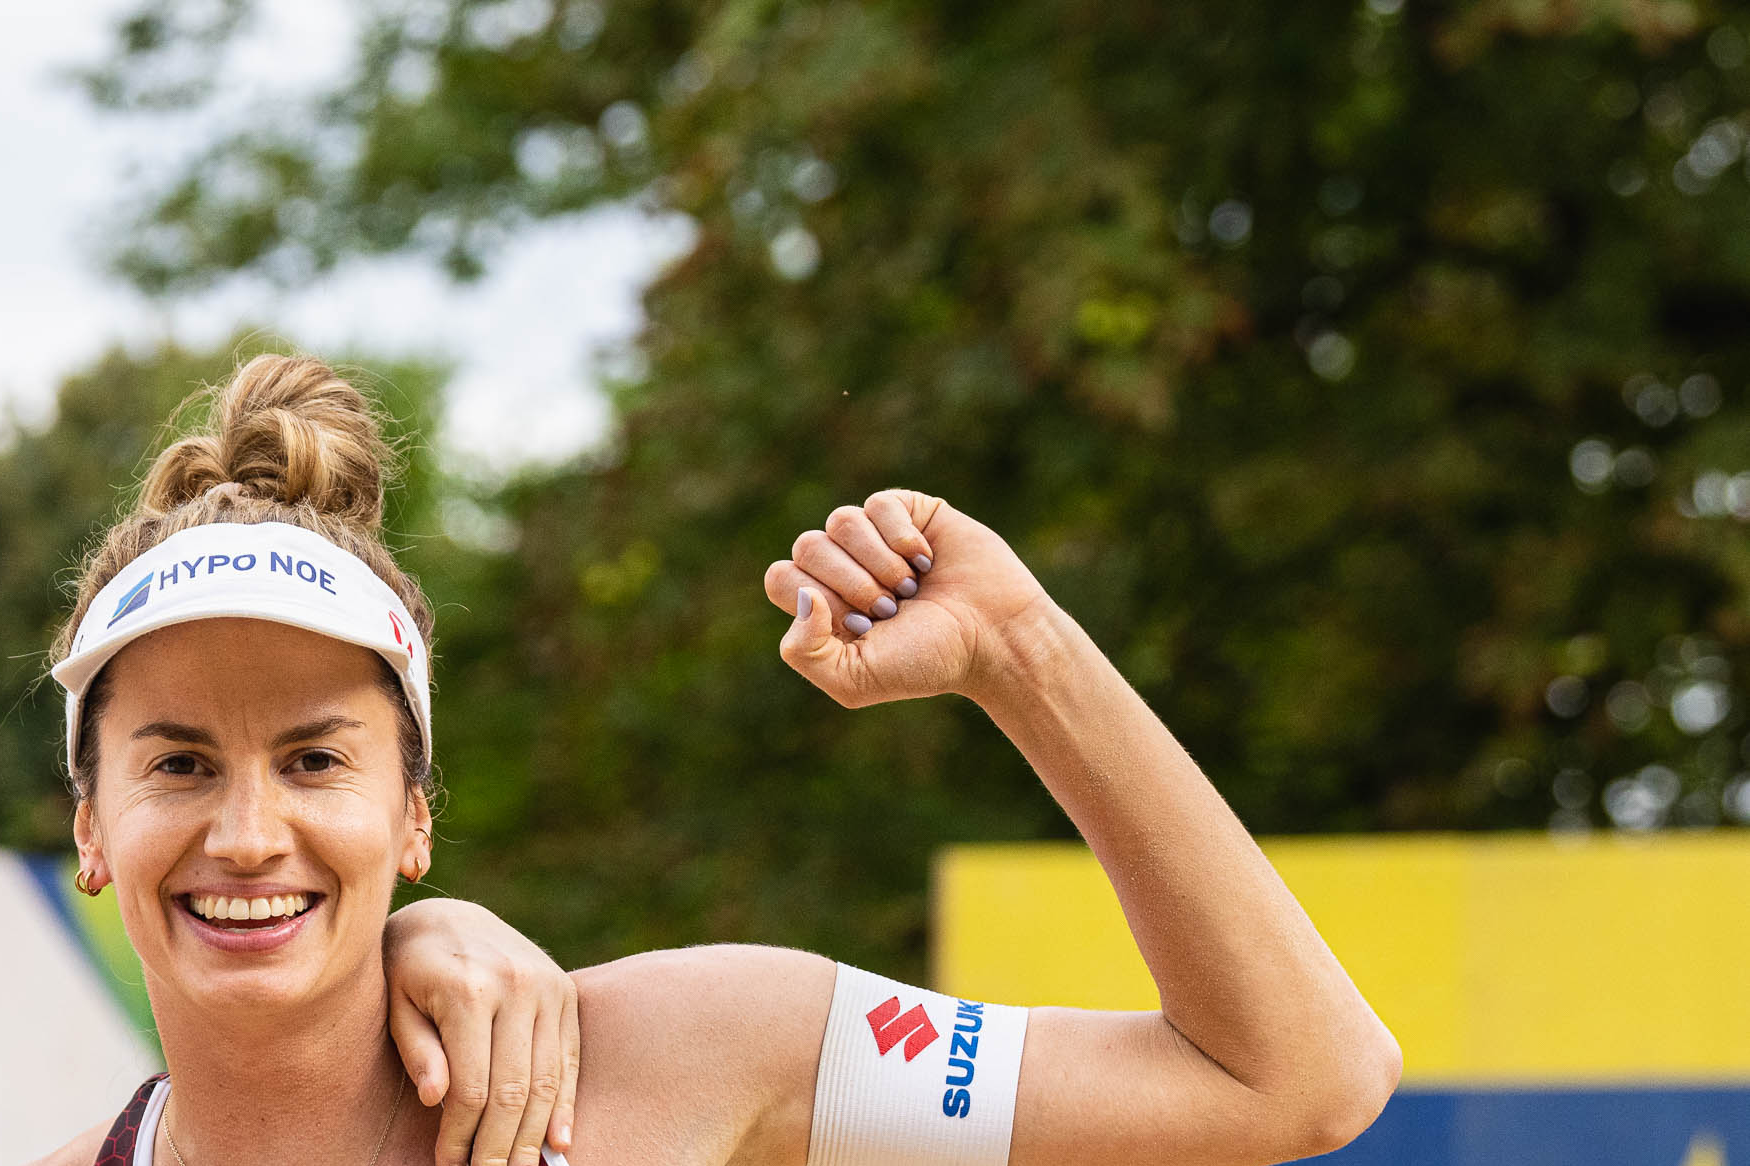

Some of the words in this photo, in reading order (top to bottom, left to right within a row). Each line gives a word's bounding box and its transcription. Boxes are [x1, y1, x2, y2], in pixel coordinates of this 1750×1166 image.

[158, 553, 257, 591] HYPO
[269, 551, 337, 596] NOE
[942, 997, 985, 1119] SUZUK
